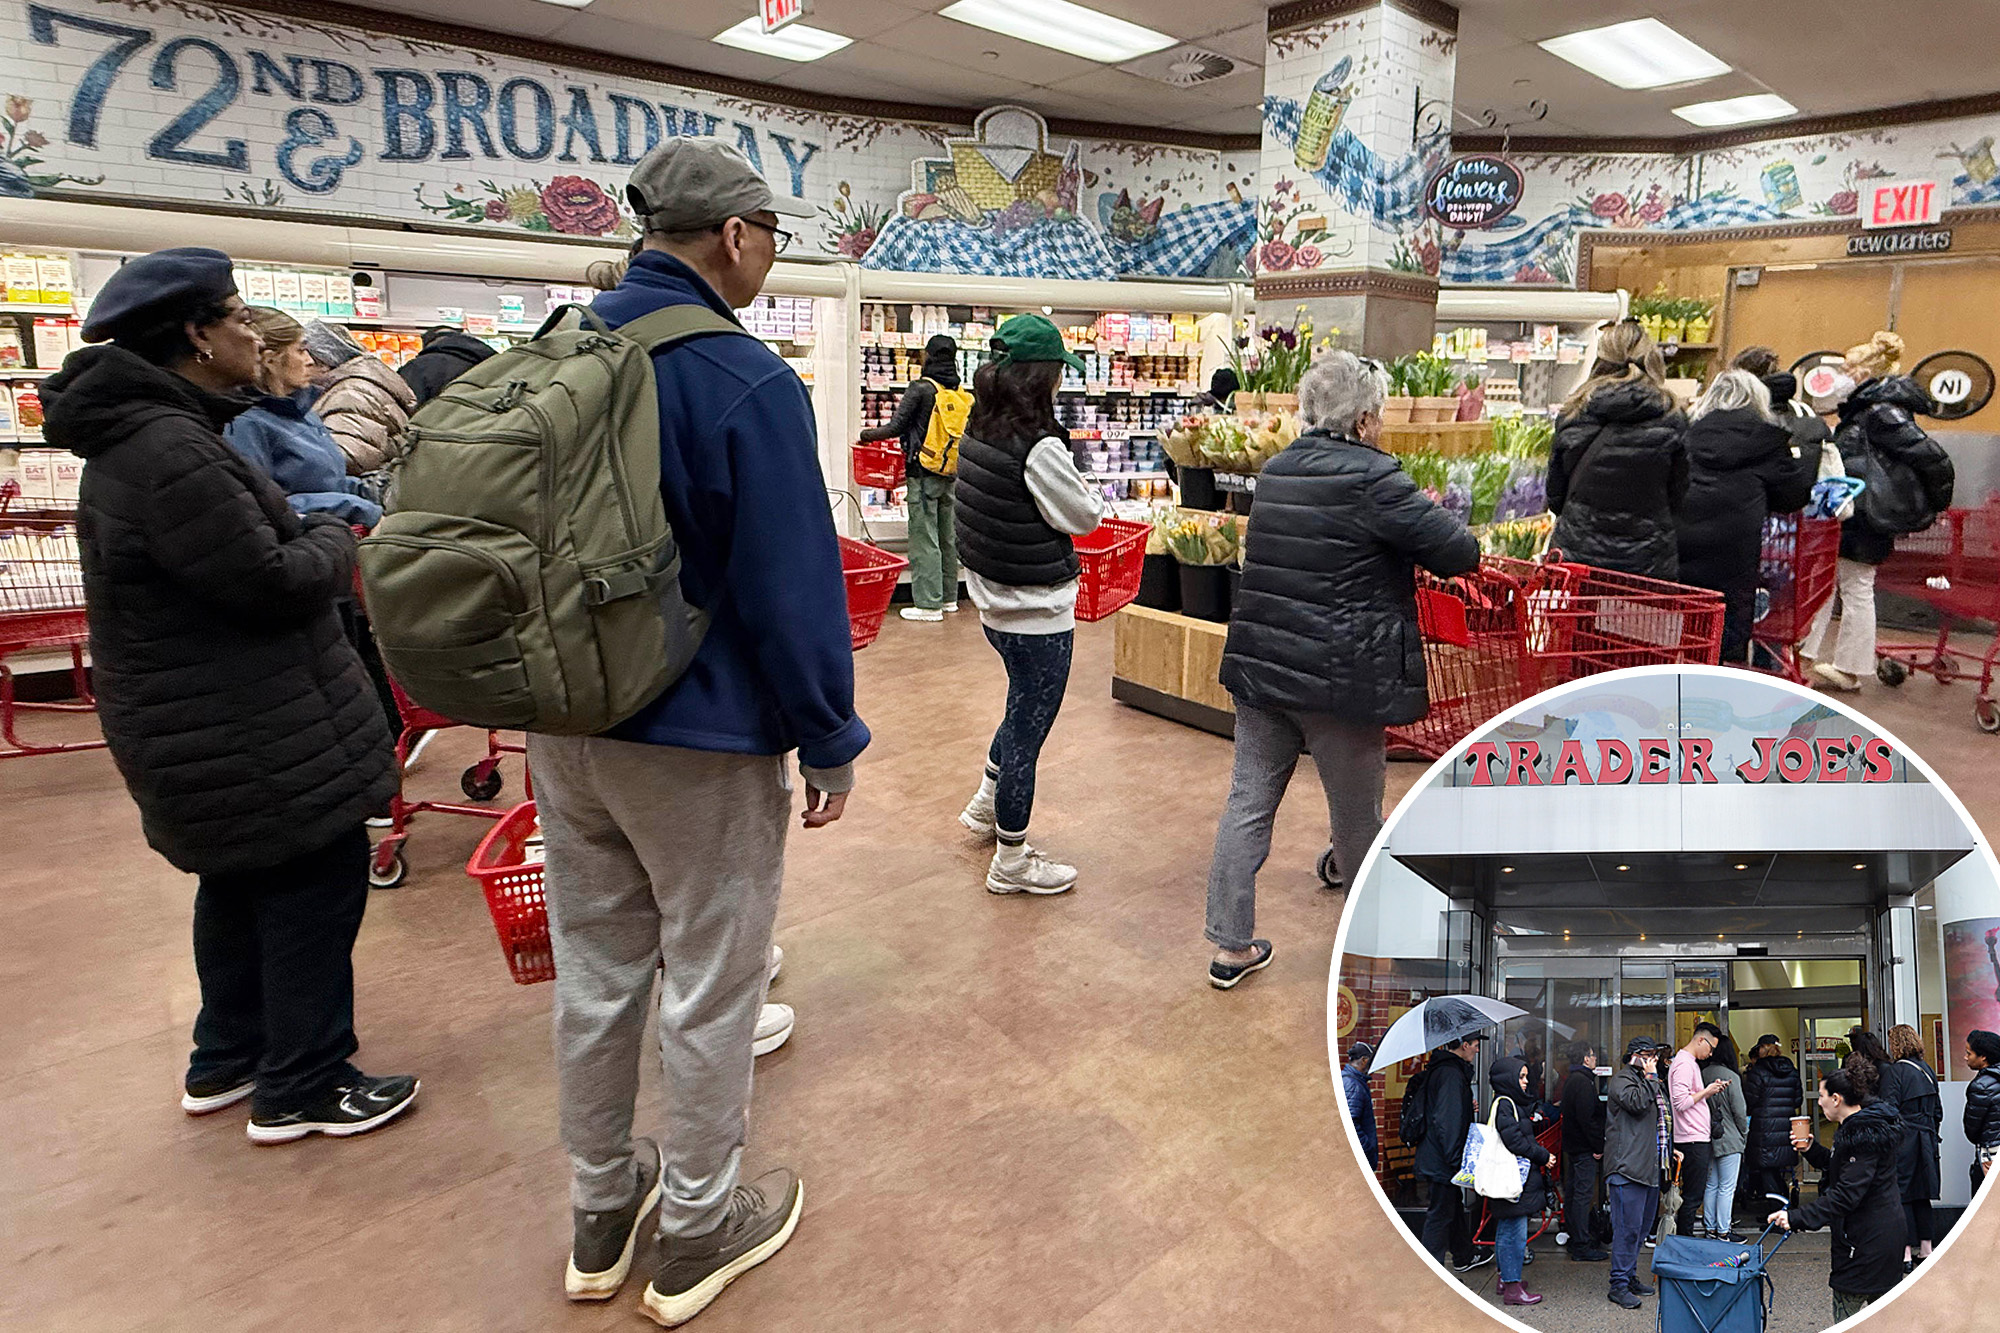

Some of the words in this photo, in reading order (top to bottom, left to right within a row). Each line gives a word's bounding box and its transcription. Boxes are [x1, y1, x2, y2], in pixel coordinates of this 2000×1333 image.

[276, 106, 364, 194] &
[1453, 160, 1499, 181] fresh
[1427, 177, 1514, 212] flowers
[1871, 183, 1936, 225] EXIT
[1463, 738, 1720, 786] TRADER
[1735, 733, 1895, 785] JOE'S
